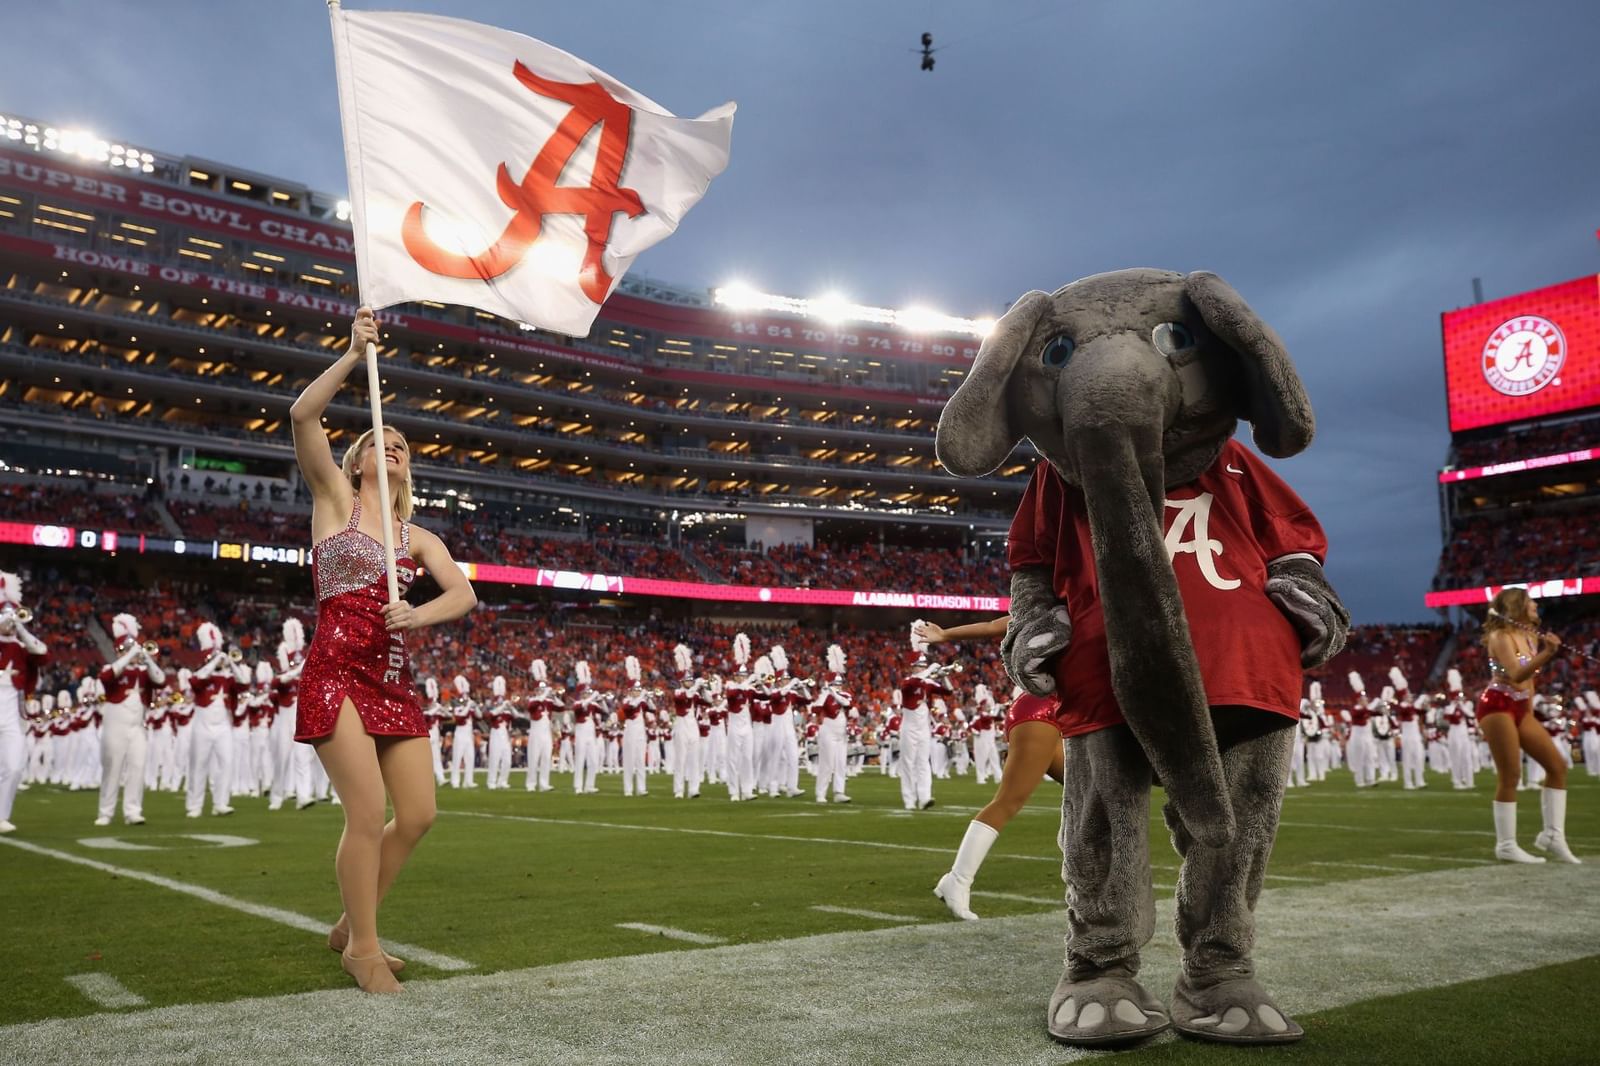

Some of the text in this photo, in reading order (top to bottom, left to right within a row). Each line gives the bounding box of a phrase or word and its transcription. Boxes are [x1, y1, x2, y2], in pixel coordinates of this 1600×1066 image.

[400, 57, 648, 304] A
[139, 189, 251, 231] BOWL
[259, 219, 356, 253] CHAM
[53, 245, 409, 328] HOME OF THE FAITHUL
[801, 328, 826, 342] 70
[867, 336, 892, 350] 74
[1502, 338, 1535, 373] A
[853, 591, 999, 610] ALABAMA CRIMSON TIDE
[383, 632, 404, 684] TIDE
